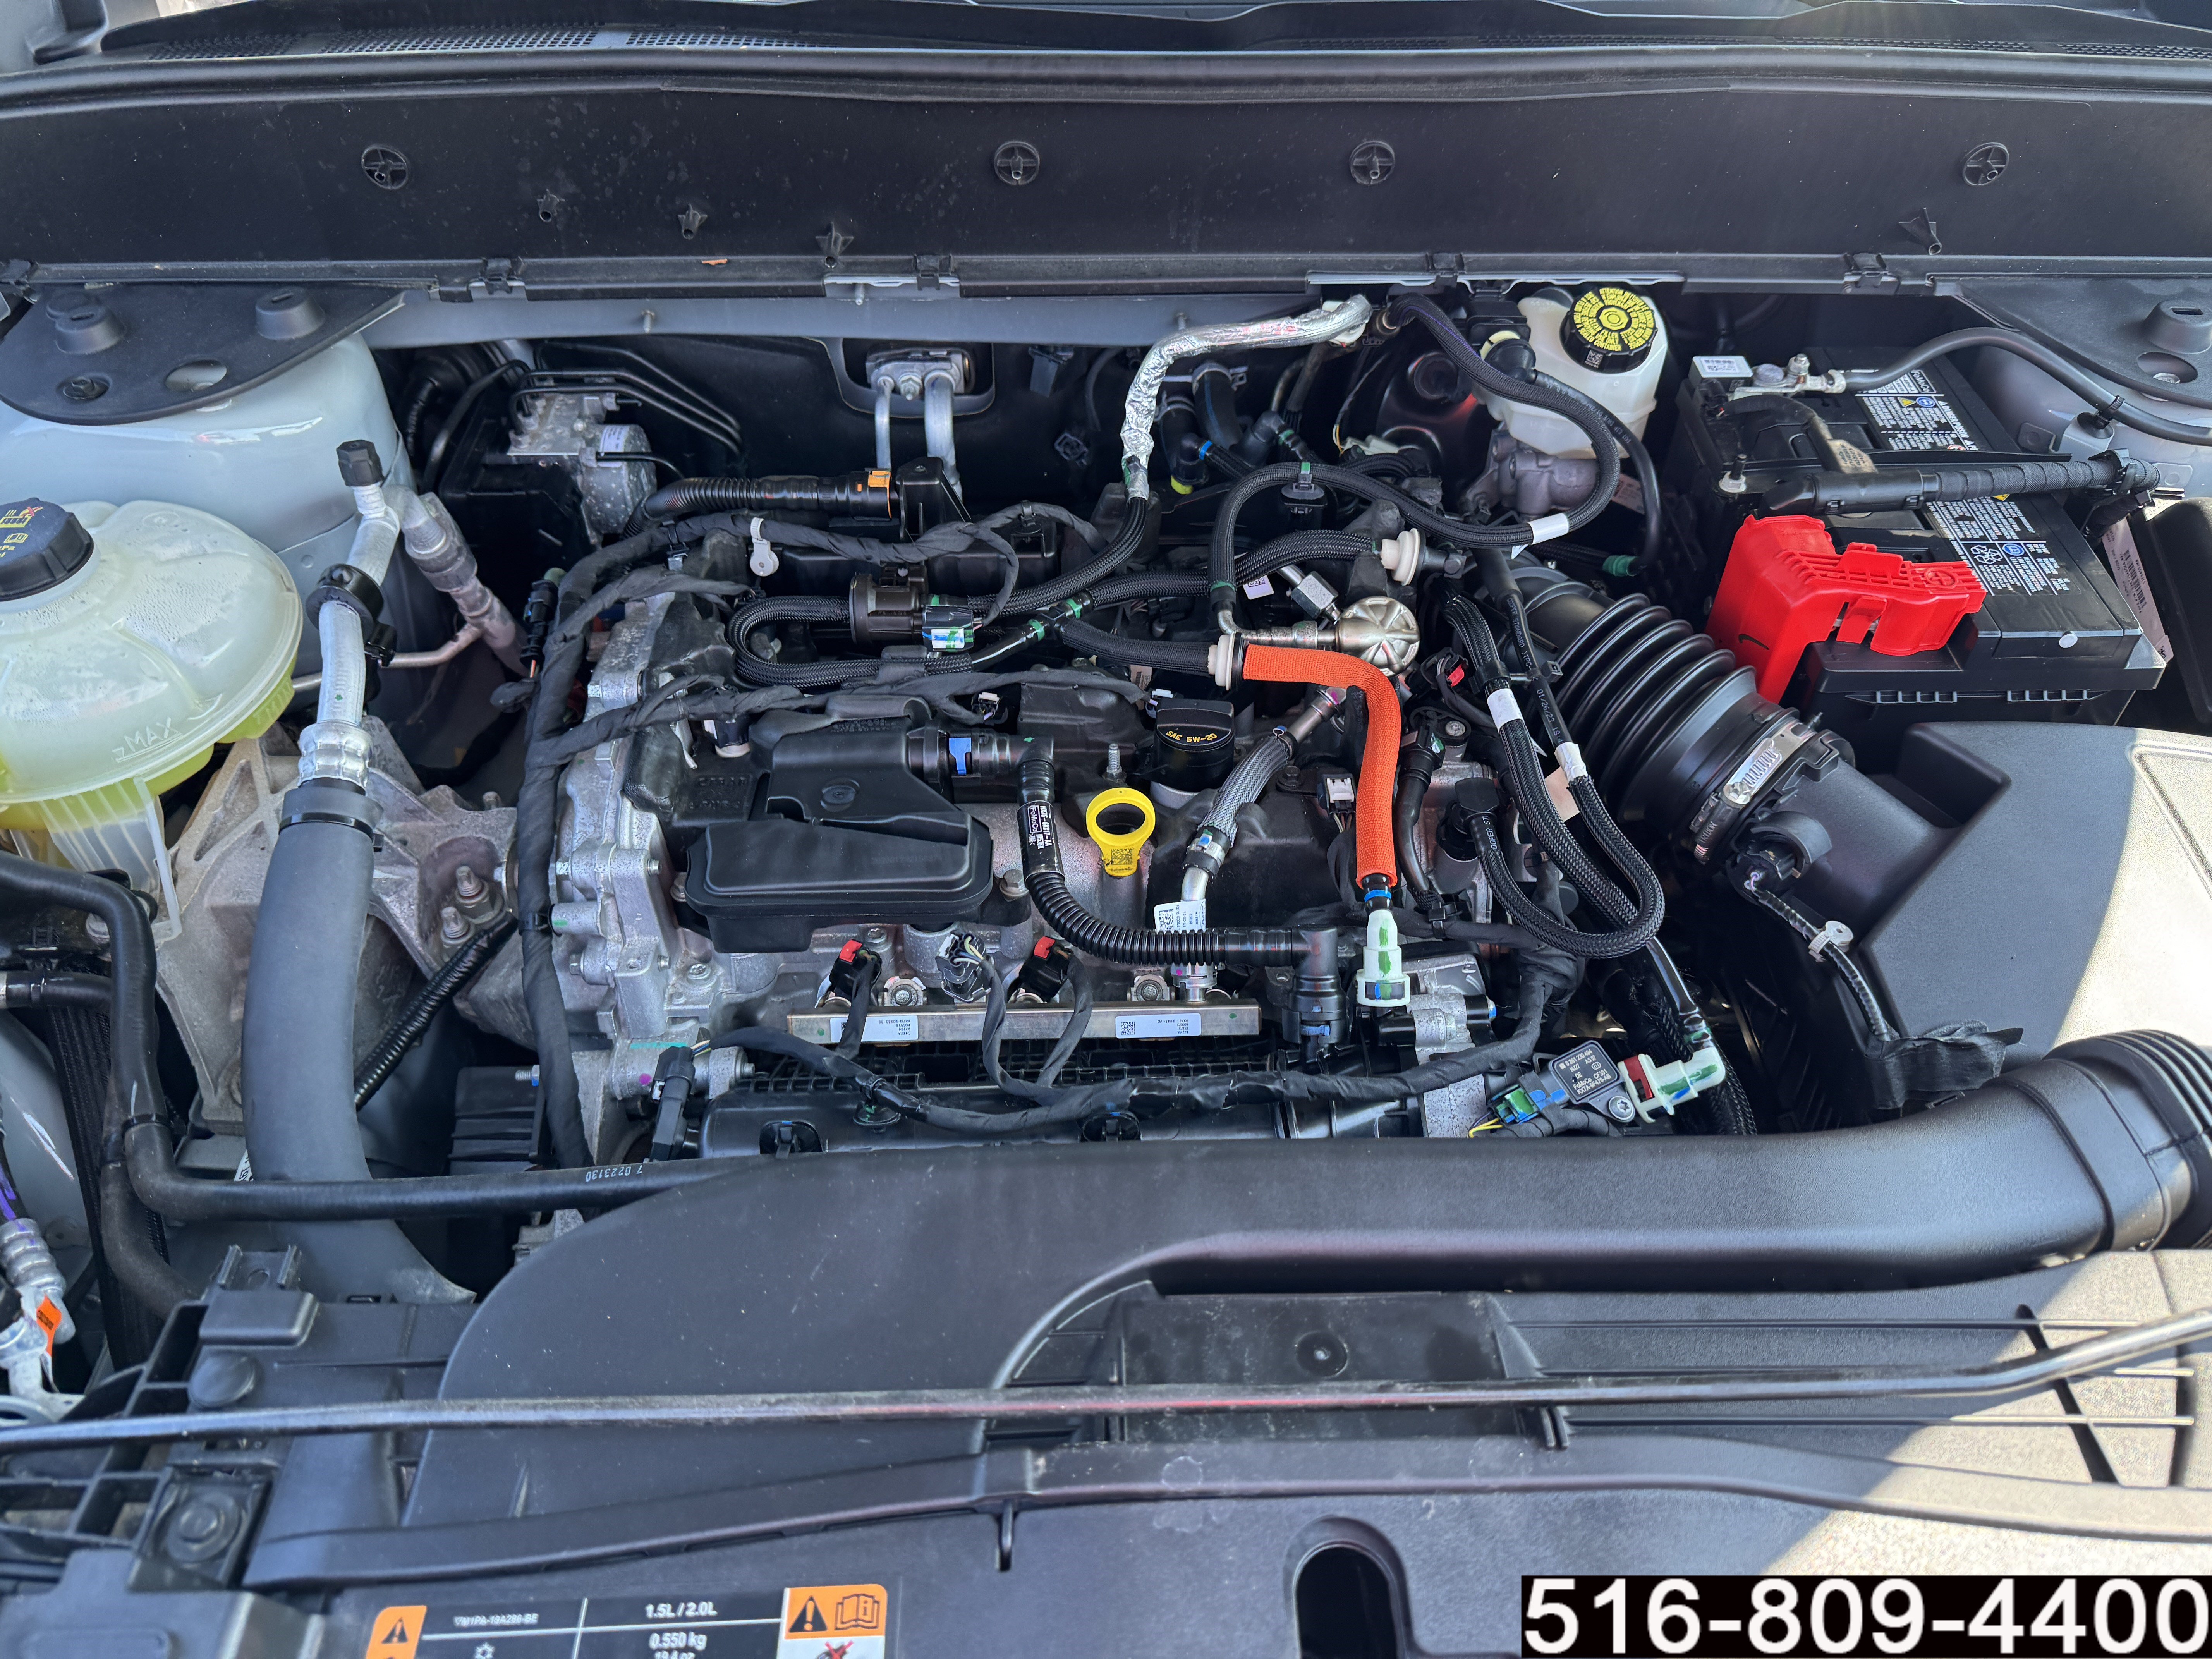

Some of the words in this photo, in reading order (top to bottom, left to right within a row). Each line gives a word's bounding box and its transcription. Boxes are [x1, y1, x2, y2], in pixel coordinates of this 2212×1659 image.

[124, 717, 183, 752] MAX
[1166, 730, 1182, 740] SAE
[1186, 733, 1218, 743] 5W-20
[1030, 807, 1039, 832] FoMoCo
[1486, 828, 1497, 850] OOPER
[1573, 1077, 1592, 1090] FoMoCo
[645, 1603, 676, 1619] 1.5L
[677, 1602, 685, 1617] /
[685, 1601, 718, 1618] 2.0L
[649, 1632, 687, 1650] 0.550
[687, 1632, 708, 1651] kg
[654, 1650, 679, 1659] 194
